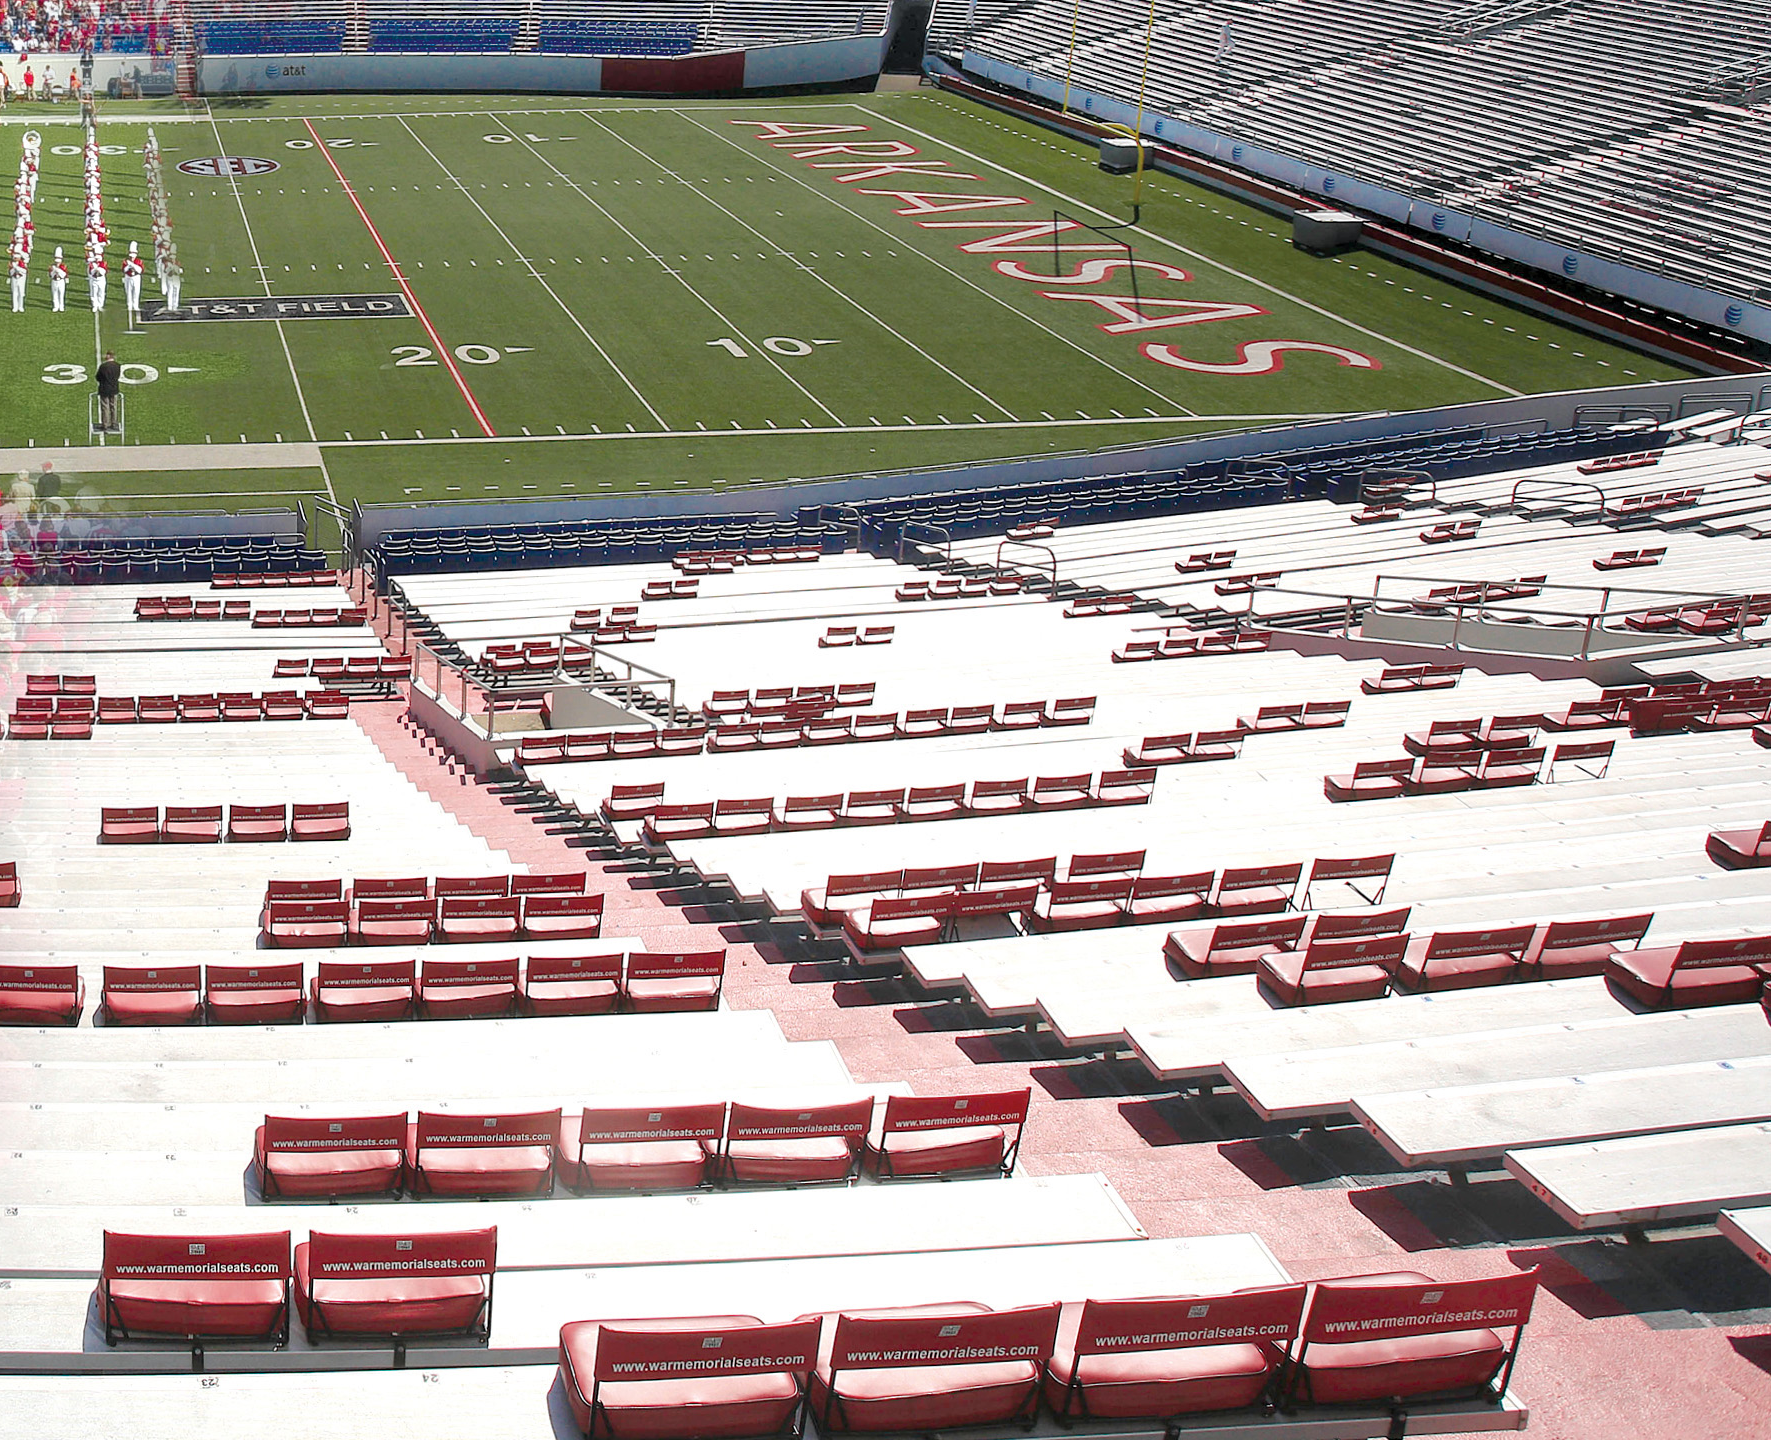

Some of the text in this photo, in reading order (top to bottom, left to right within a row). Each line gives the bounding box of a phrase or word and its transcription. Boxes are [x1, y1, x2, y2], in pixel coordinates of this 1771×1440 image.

[282, 65, 307, 77] at&t
[183, 157, 277, 177] SEC
[728, 119, 1384, 376] ARKANSAS
[275, 294, 395, 316] FIELD
[705, 335, 815, 360] 10
[389, 343, 503, 369] 20
[40, 362, 159, 387] 30
[532, 970, 619, 982] www.warmemorialseats.com
[633, 965, 720, 978] www.warmemorialseats.com
[109, 981, 197, 991] www.warmemorialseats.com
[210, 979, 298, 990] www.warmemorialseats.com
[323, 976, 411, 988] www.warmemorialseats.com
[427, 974, 514, 986] www.warmemorialseats.com
[894, 1110, 1021, 1129] www.warmemorialseats.com
[589, 1127, 715, 1142] www.warmemorialseats.com
[737, 1122, 864, 1137] www.warmemorialseats.com
[272, 1136, 398, 1150] www.warmemorialseats.com
[425, 1131, 552, 1144] www.warmemorialseats.com
[115, 1262, 279, 1275] www.warmemorialseats.com
[322, 1258, 486, 1273] www.warmemorialseats.com
[1324, 1307, 1519, 1333] www.warmemorialseats.com
[1095, 1322, 1289, 1347] www.warmemorialseats.com
[846, 1344, 1040, 1362] www.warmemorialseats.com
[611, 1354, 806, 1373] www.warmemorialseats.com
[201, 1377, 215, 1388] 23
[422, 1373, 439, 1383] 24
